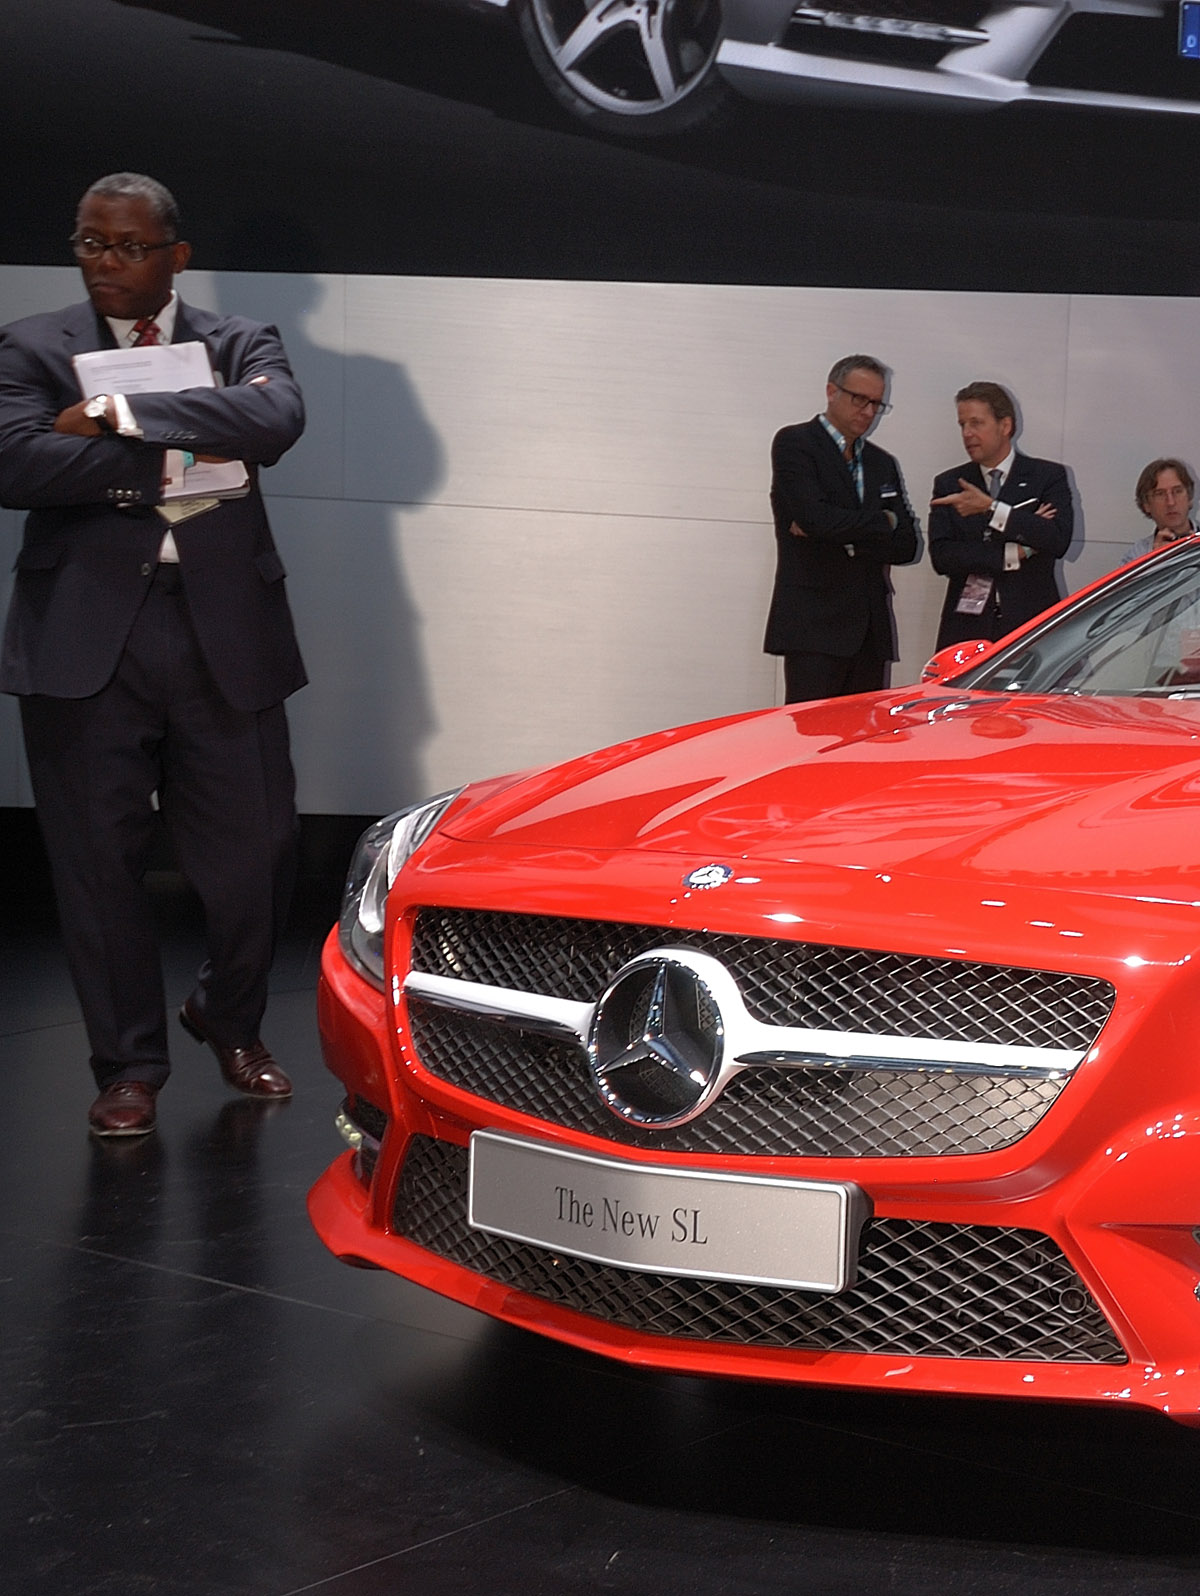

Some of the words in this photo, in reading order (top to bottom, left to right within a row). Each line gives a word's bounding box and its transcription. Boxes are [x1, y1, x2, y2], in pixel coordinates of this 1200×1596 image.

[1186, 35, 1197, 48] D
[555, 1186, 594, 1228] The
[601, 1197, 660, 1240] New
[671, 1207, 708, 1245] SL
